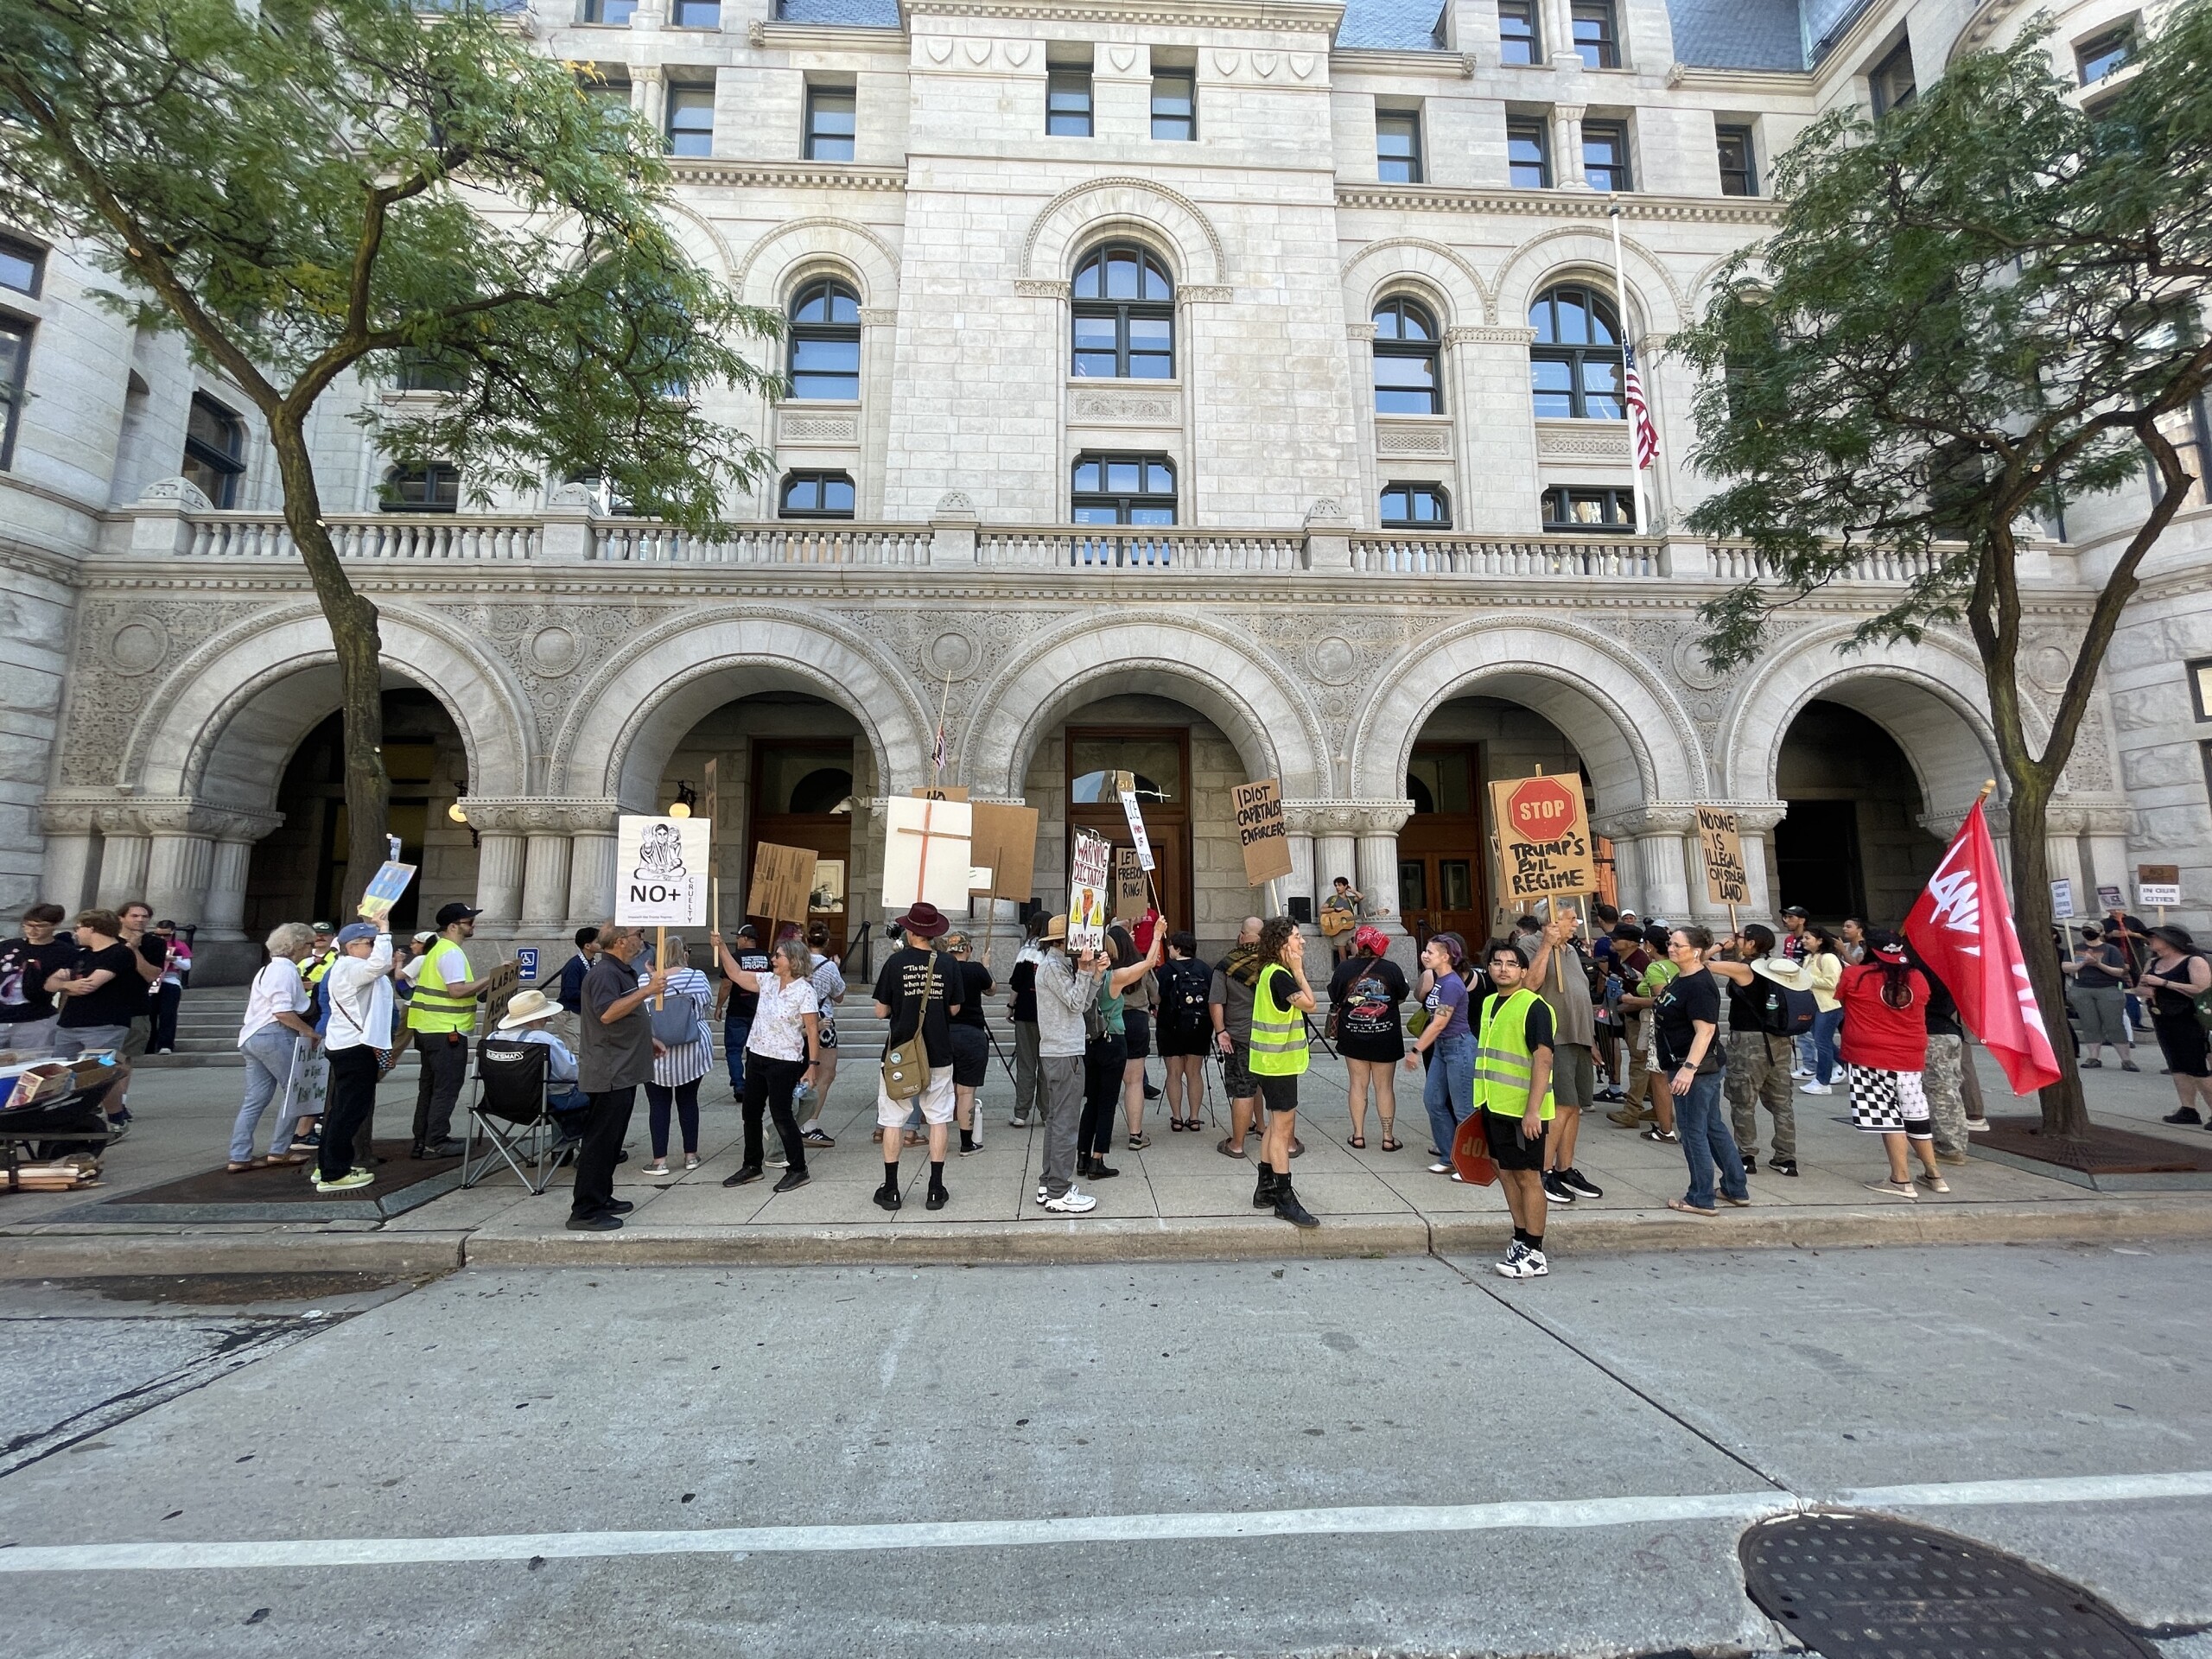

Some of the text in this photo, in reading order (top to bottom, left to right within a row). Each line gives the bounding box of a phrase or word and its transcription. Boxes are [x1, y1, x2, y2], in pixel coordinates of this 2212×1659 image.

[1237, 786, 1270, 808] IDIOT
[1124, 799, 1140, 820] ICE
[1520, 799, 1565, 820] STOP
[1241, 821, 1286, 846] ENFORCERS
[1712, 833, 1725, 851] IS
[1076, 835, 1109, 868] WARNING
[1510, 831, 1585, 861] TRUMP'S
[1121, 851, 1137, 865] LET
[1518, 857, 1557, 874] EVIL
[1705, 849, 1742, 870] ILLEGAL
[1073, 861, 1105, 887] DICTATOR
[1118, 867, 1146, 880] FREEDOM
[1512, 869, 1585, 894] REGIME
[1710, 868, 1724, 880] ON
[631, 885, 681, 902] NO+
[1123, 880, 1144, 899] RING!
[1719, 881, 1743, 902] LAND
[492, 966, 519, 993] LABOR
